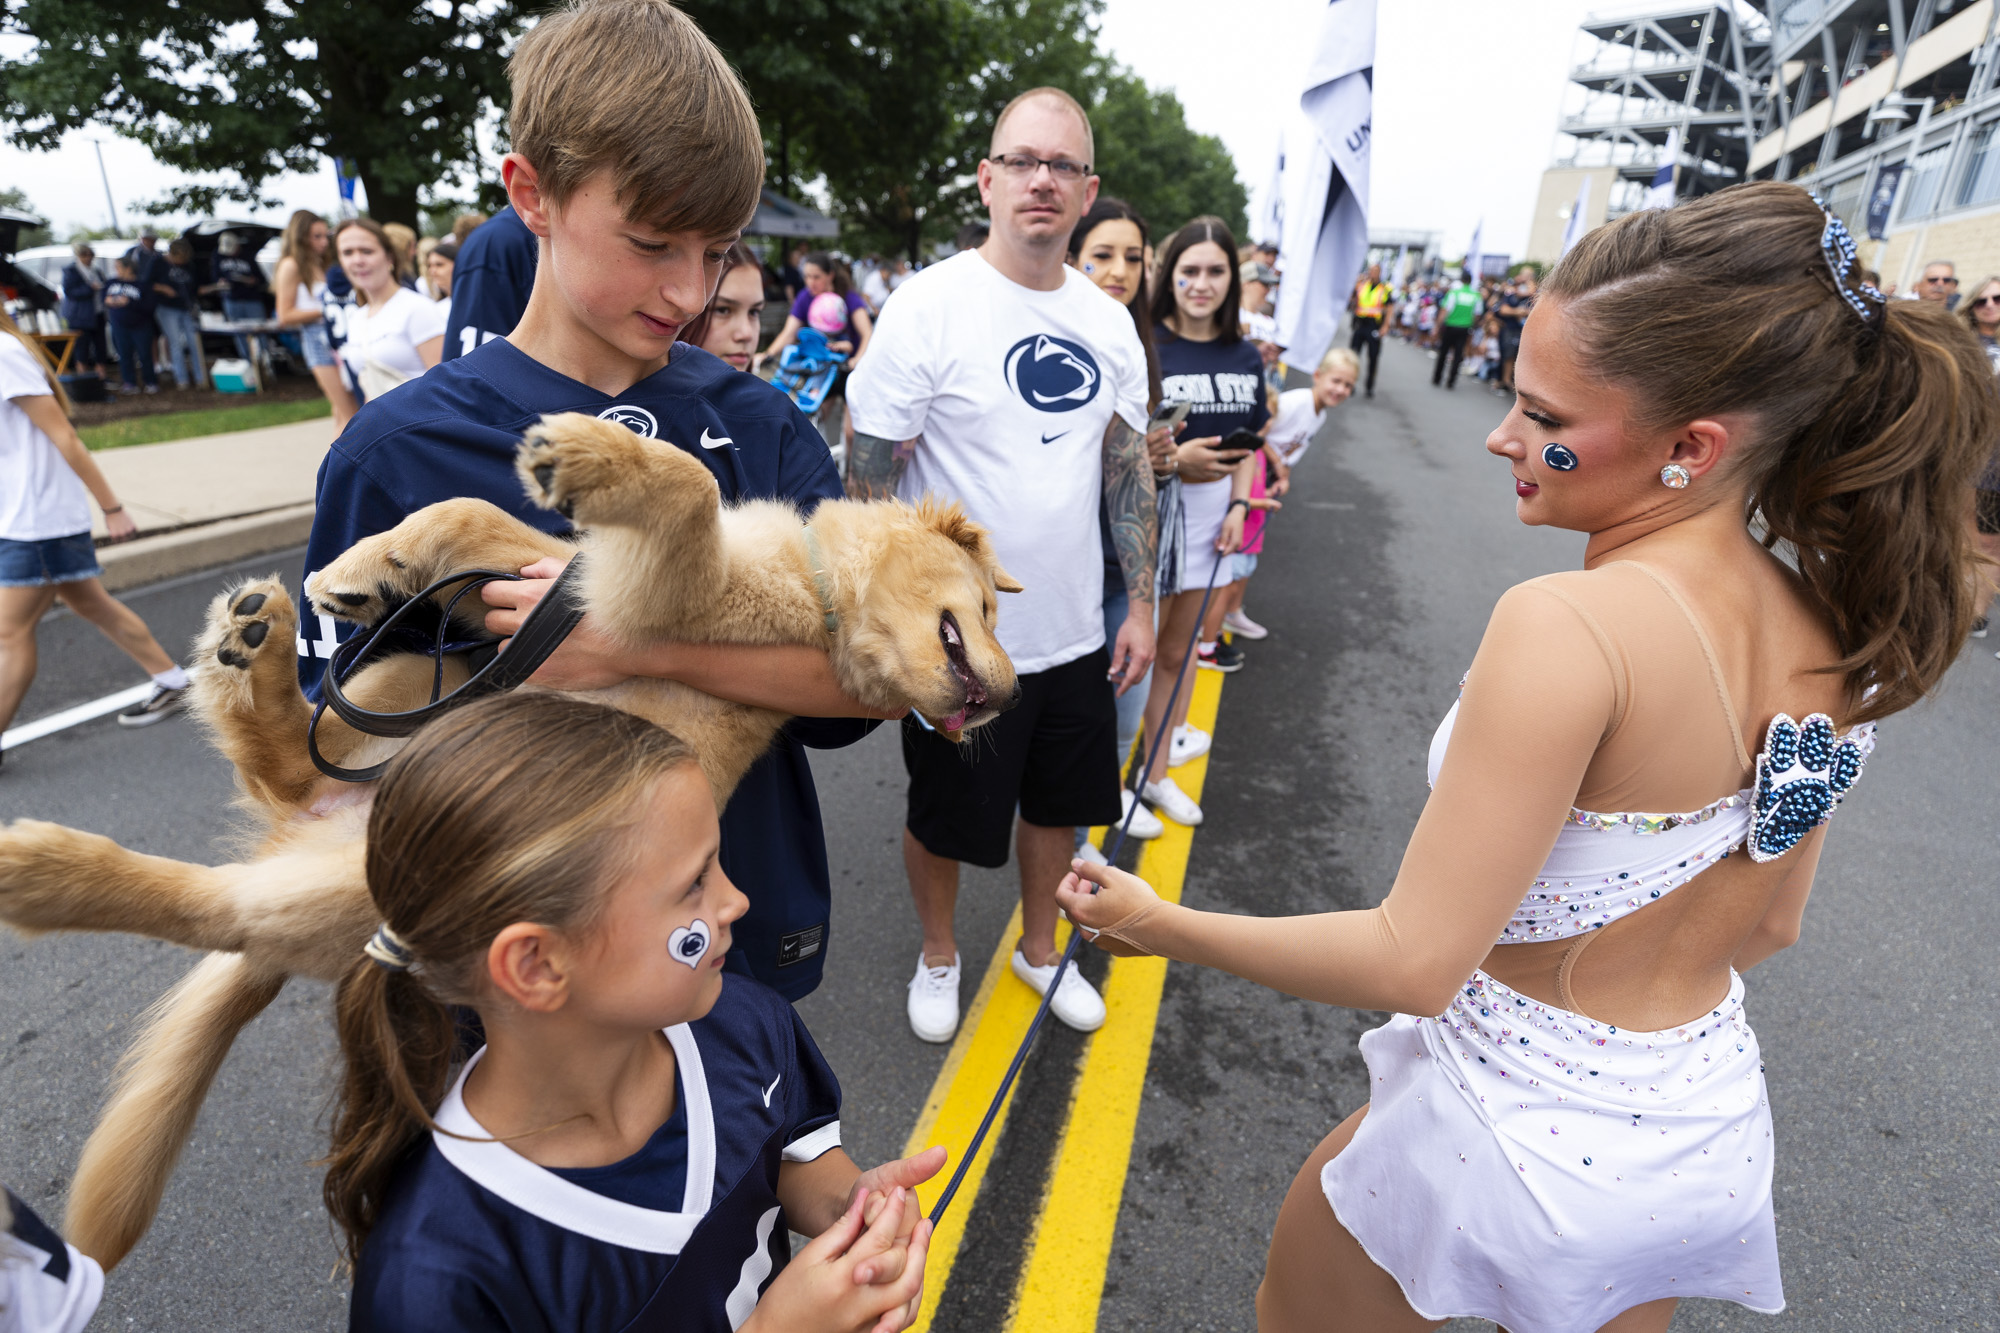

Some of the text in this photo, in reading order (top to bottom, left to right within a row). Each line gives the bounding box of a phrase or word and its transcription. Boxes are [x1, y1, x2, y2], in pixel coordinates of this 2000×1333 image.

[459, 325, 507, 357] 1
[1161, 373, 1258, 405] PENN STATE
[1190, 402, 1251, 414] UNIVERSITY
